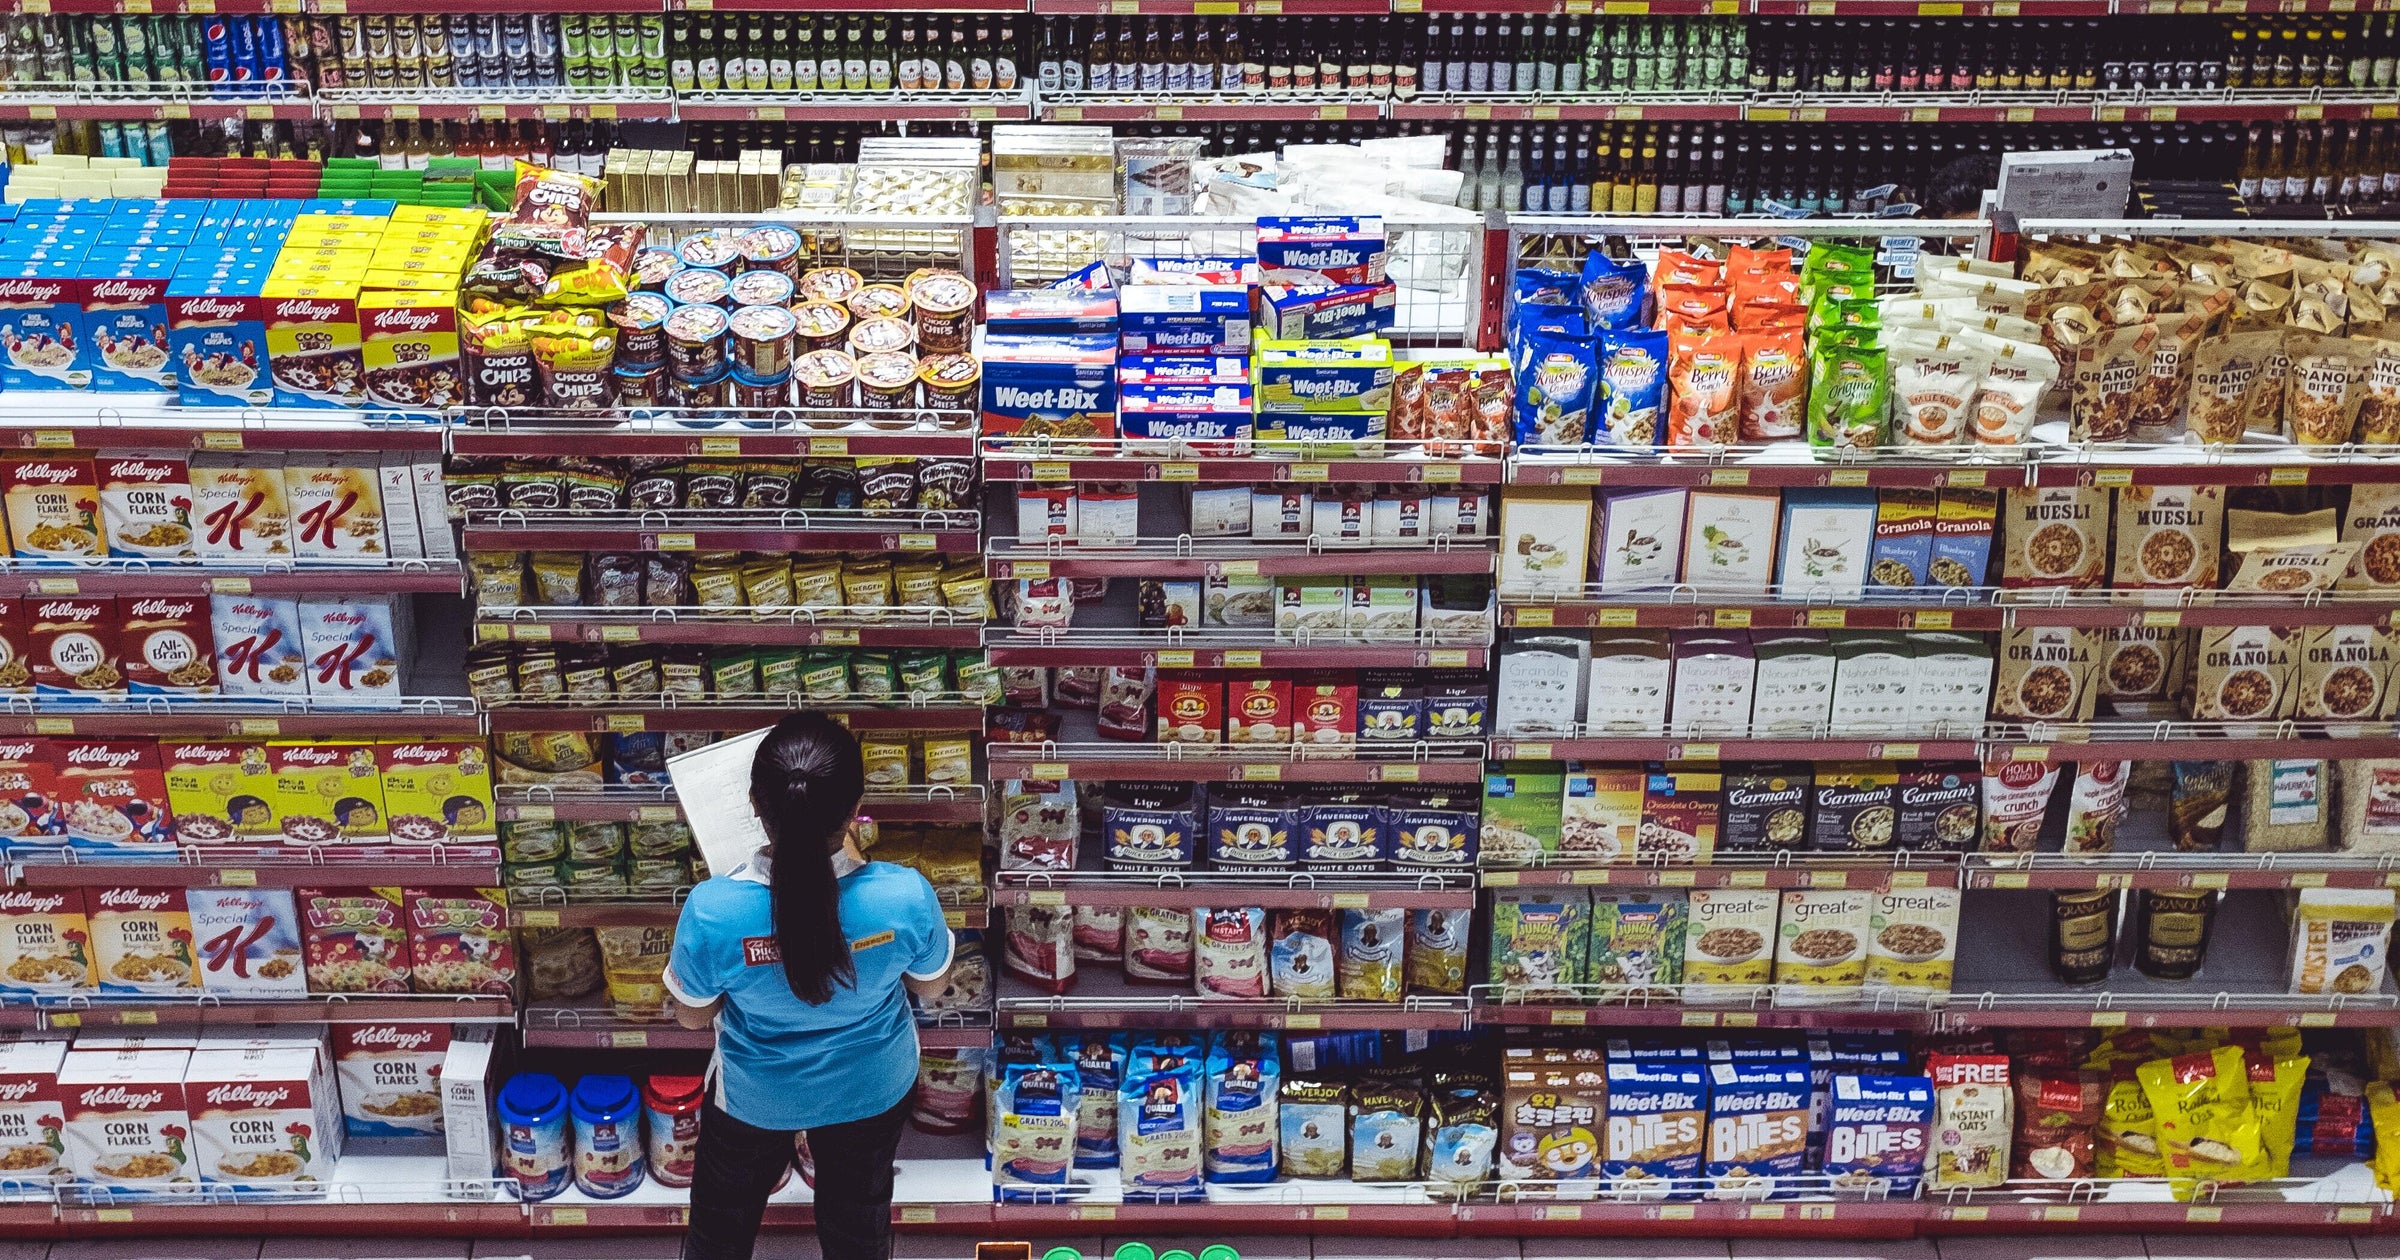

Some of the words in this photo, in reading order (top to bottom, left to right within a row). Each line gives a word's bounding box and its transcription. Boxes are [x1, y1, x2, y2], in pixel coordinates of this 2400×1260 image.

[530, 190, 580, 208] CHIPS
[1283, 249, 1360, 266] Weet-Bix
[1157, 261, 1234, 272] Weet-Bix
[93, 280, 156, 300] Kellogg's
[1585, 287, 1632, 301] Knusper
[181, 298, 244, 318] Kellogg's
[277, 299, 340, 319] Kellogg's
[375, 310, 440, 332] Kellogg's
[295, 332, 333, 343] COCO
[630, 334, 656, 342] CHOCO
[392, 343, 430, 352] COCO
[484, 356, 527, 367] CHOCO
[481, 368, 532, 384] CHIPS
[556, 372, 596, 382] CHOCO
[1605, 364, 1657, 377] Knusper
[1691, 369, 1730, 383] Berry
[1753, 365, 1793, 381] Berry
[2292, 365, 2365, 385] GRANOLA
[1536, 371, 1584, 385] Knusper
[1619, 376, 1649, 386] Crunch
[552, 382, 603, 397] CHIPS
[1293, 379, 1360, 394] Weet-Bix
[1696, 380, 1721, 392] Crunch
[1828, 379, 1877, 399] Original
[2101, 381, 2138, 393] BITES
[2308, 381, 2343, 394] BITES
[995, 386, 1098, 409] Weet-Bix
[1313, 392, 1340, 403] Kids
[1430, 396, 1456, 407] Berry
[1478, 397, 1504, 408] Berry
[1148, 421, 1227, 437] Weet-Bix
[15, 463, 77, 482] Kellogg's
[110, 461, 172, 481] Kellogg's
[36, 494, 67, 504] CORN
[128, 492, 166, 504] CORN
[200, 487, 241, 500] Special
[294, 487, 334, 498] Special
[37, 505, 69, 514] FLAKES
[130, 505, 167, 515] FLAKES
[2025, 504, 2090, 521] MUESLI
[204, 491, 265, 550] K
[298, 491, 359, 549] K
[2137, 510, 2204, 527] MUESLI
[1877, 520, 1933, 535] Granola
[1935, 520, 1992, 533] Granola
[1881, 545, 1917, 558] Blueberry
[1939, 544, 1976, 558] Blueberry
[2261, 557, 2328, 567] MUESLI
[39, 602, 100, 621] Kellogg's
[132, 599, 193, 618] Kellogg's
[221, 622, 261, 634] Special
[312, 632, 352, 642] Special
[67, 643, 88, 653] All-
[159, 640, 182, 651] All-
[60, 652, 94, 663] Bran
[153, 649, 187, 660] Bran
[226, 629, 282, 683] K
[2008, 645, 2090, 662] GRANOLA
[2206, 651, 2288, 667] GRANOLA
[2308, 646, 2389, 662] GRANOLA
[315, 633, 375, 690] K
[1509, 663, 1569, 678] Granola
[1761, 669, 1799, 678] Natural
[1841, 667, 1877, 678] Natural
[68, 745, 141, 767] Kellogg's
[175, 745, 231, 761] Kellogg's
[283, 748, 339, 764] Kellogg's
[393, 746, 449, 762] Kellogg's
[1241, 797, 1267, 806] Ligo
[1731, 787, 1802, 805] Carman's
[1820, 787, 1892, 805] Carman's
[1903, 787, 1975, 804] Carman's
[1134, 799, 1162, 809] Ligo
[1594, 803, 1639, 813] Chocolate
[1646, 801, 1687, 809] Chocolate
[1689, 801, 1719, 810] Cherry
[2004, 801, 2038, 812] crunch
[1119, 816, 1174, 824] HAVERMOUT
[1112, 864, 1150, 872] WHITE
[1701, 900, 1754, 921] great
[1795, 900, 1848, 922] great
[1882, 895, 1937, 915] great
[199, 913, 247, 924] Special
[307, 909, 394, 928] HOOPS
[412, 909, 499, 928] HOOPS
[15, 923, 53, 935] CORN
[121, 921, 158, 932] CORN
[1519, 923, 1560, 934] JUNGLE
[1619, 923, 1658, 934] JUNGLE
[17, 934, 55, 944] FLAKES
[123, 933, 161, 943] FLAKES
[203, 916, 275, 979] K
[373, 1062, 417, 1076] CORN
[1952, 1064, 2008, 1082] FREE
[375, 1075, 419, 1086] FLAKES
[1022, 1080, 1056, 1090] QUAKER
[1224, 1081, 1258, 1090] QUAKER
[1609, 1092, 1698, 1111] Weet-Bix
[1714, 1092, 1803, 1112] Weet-Bix
[1145, 1104, 1176, 1114] QUAKER
[1834, 1107, 1924, 1122] Weet-Bix
[1950, 1110, 1995, 1121] INSTANT
[230, 1120, 274, 1133] CORN
[1019, 1118, 1048, 1126] GRATIS
[1958, 1121, 1988, 1131] OATS
[105, 1123, 149, 1135] CORN
[107, 1135, 151, 1146] FLAKES
[232, 1133, 276, 1144] FLAKES
